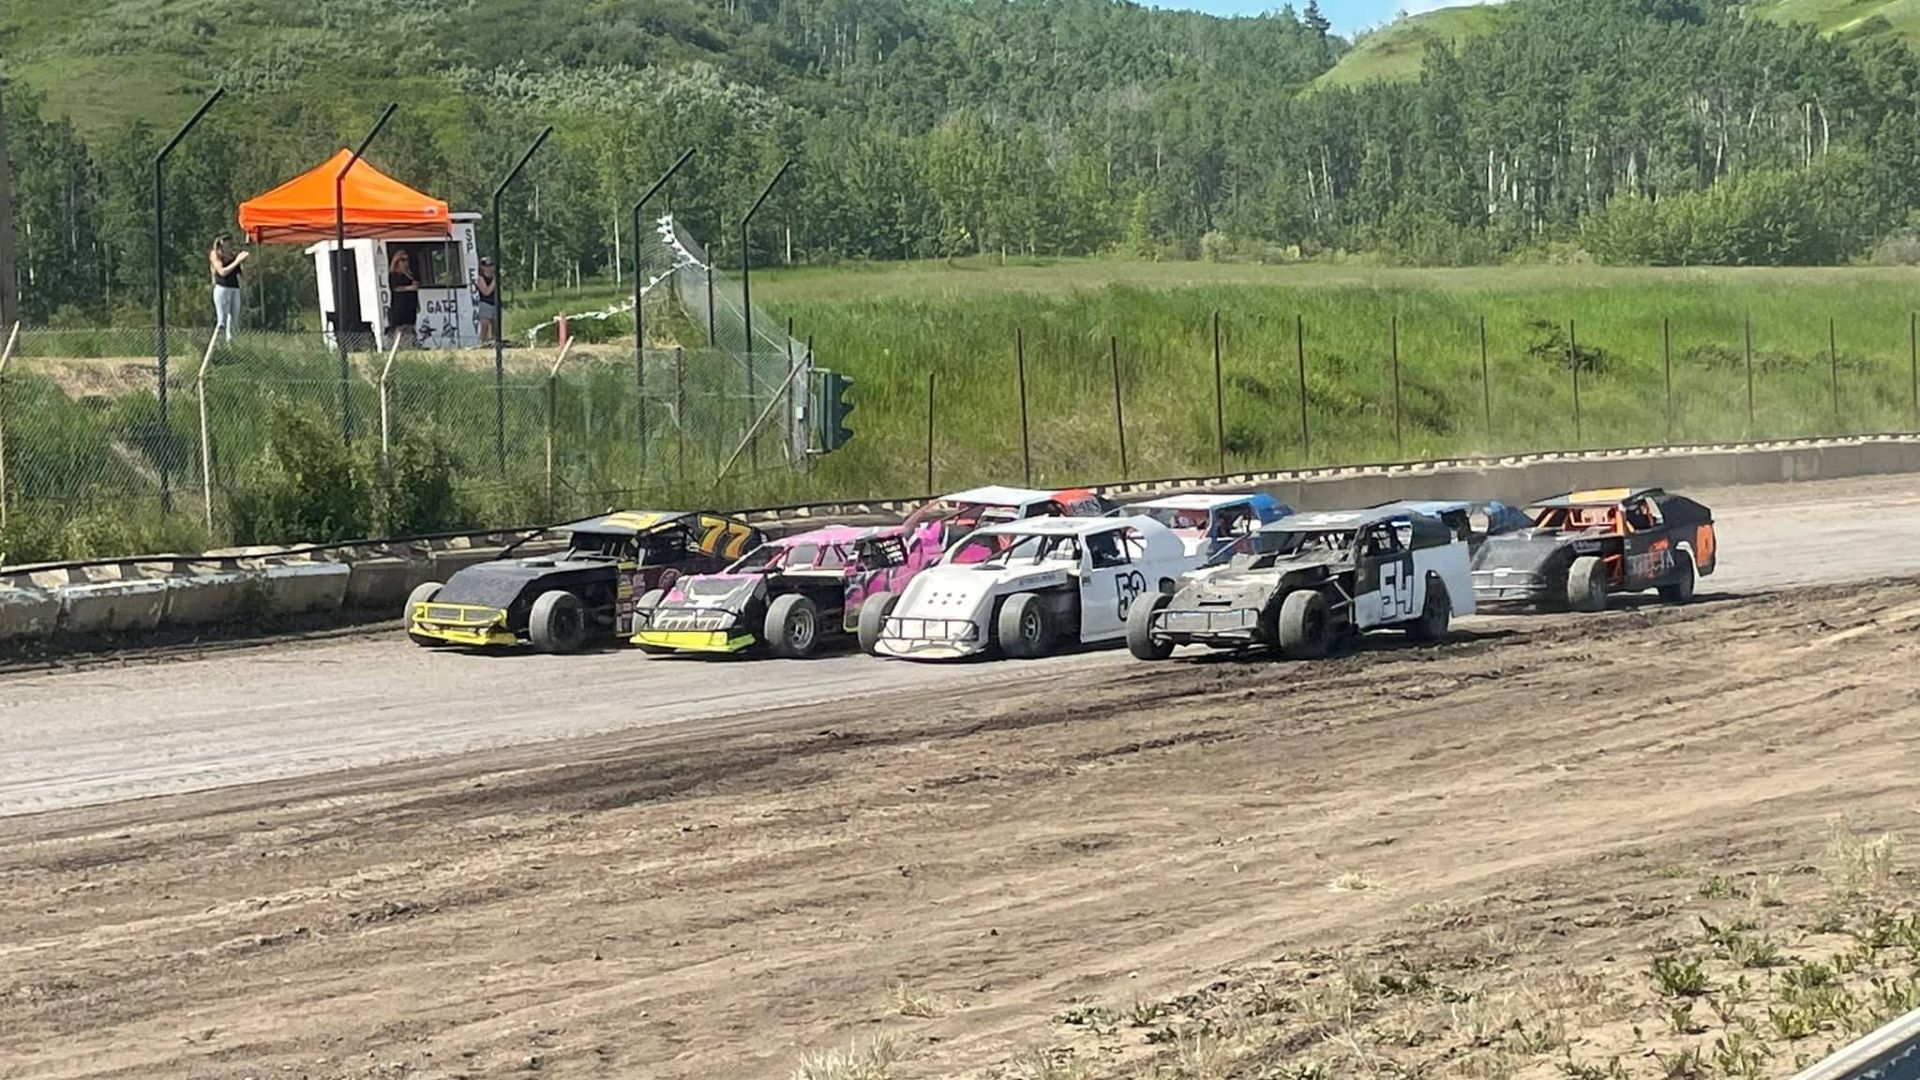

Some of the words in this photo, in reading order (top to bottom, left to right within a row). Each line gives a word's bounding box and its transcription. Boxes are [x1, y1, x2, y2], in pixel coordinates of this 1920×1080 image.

[426, 300, 457, 314] GATE
[697, 513, 754, 560] 77
[1379, 560, 1413, 621] 54
